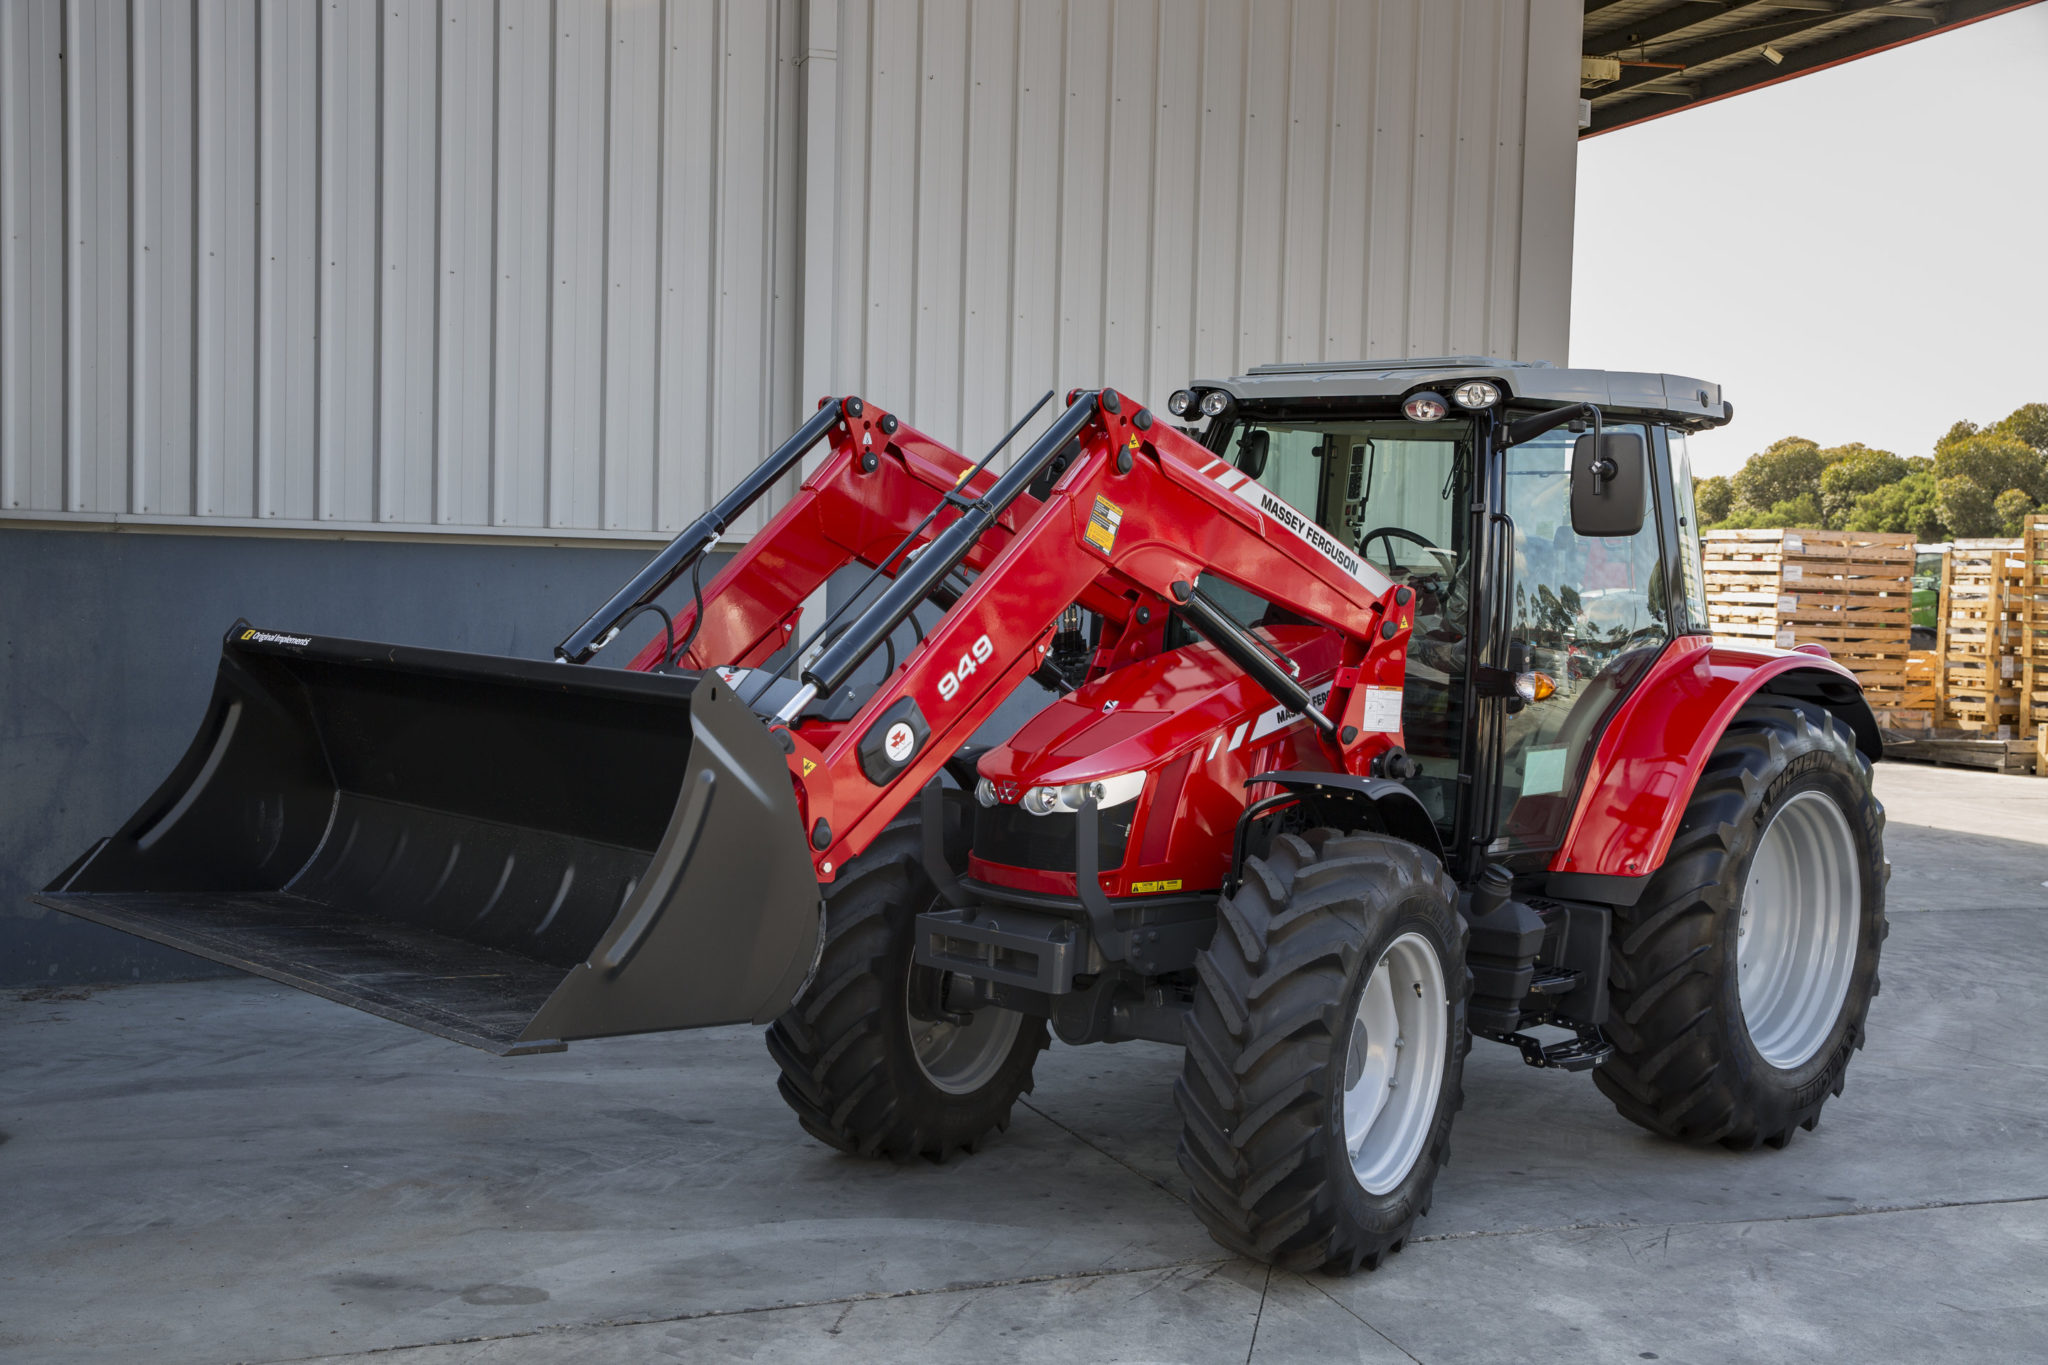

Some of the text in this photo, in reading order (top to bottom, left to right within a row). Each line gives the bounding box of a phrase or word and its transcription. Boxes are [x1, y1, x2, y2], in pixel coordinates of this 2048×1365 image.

[1261, 494, 1359, 576] MASSEY FERGUSON
[252, 632, 278, 642] Original
[937, 634, 994, 702] 949
